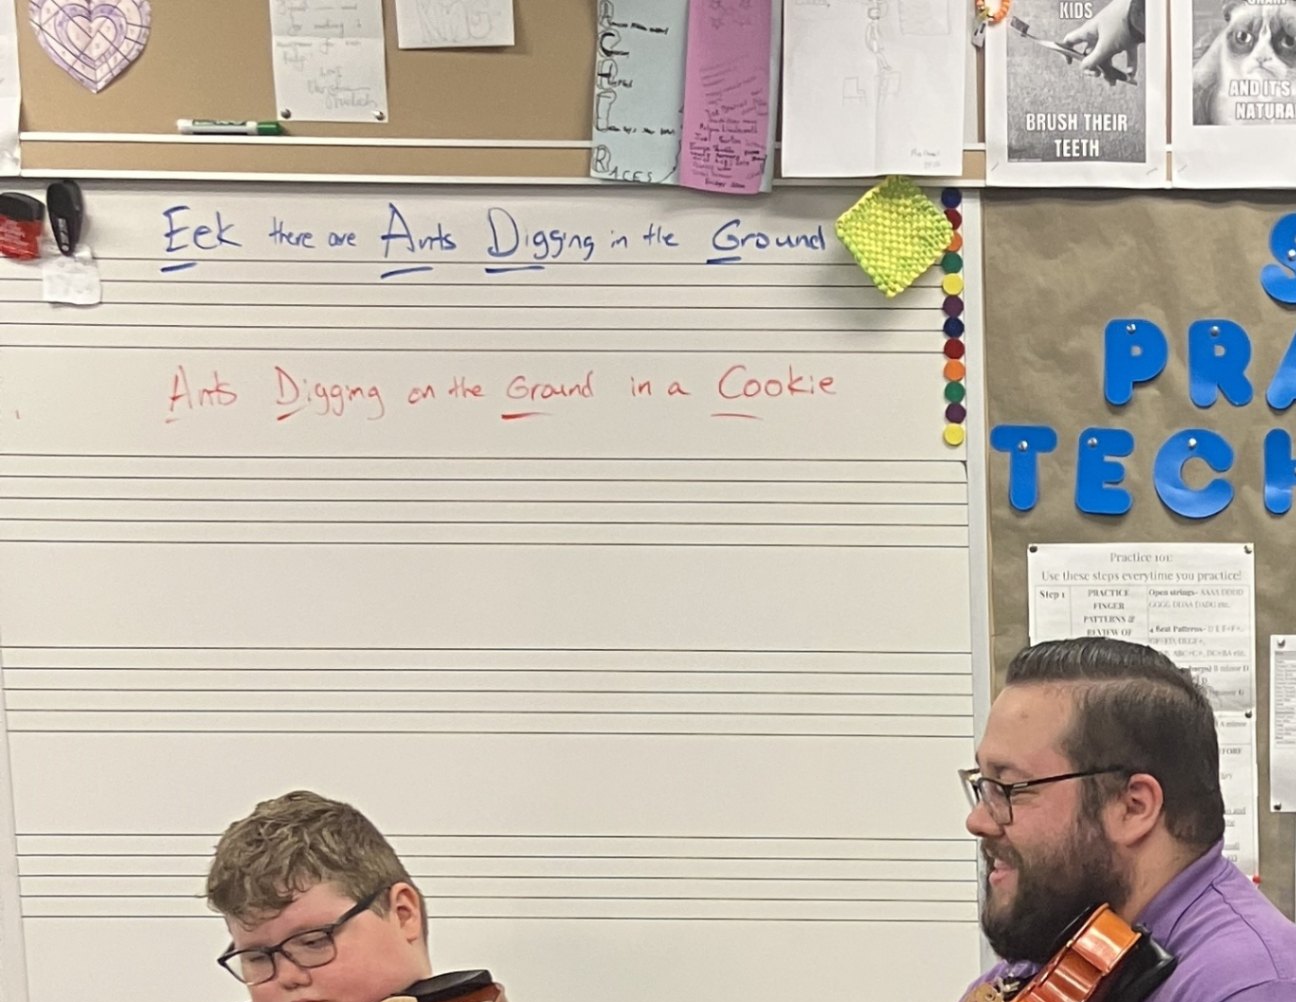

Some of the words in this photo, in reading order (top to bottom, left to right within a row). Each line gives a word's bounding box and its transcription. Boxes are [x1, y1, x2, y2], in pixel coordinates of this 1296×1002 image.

[1059, 1, 1093, 19] KIDS
[1229, 79, 1259, 97] AND
[1262, 80, 1291, 97] IT'S
[1026, 113, 1078, 131] BRUSH
[1084, 113, 1128, 131] THEIR
[1054, 139, 1100, 157] TEETH
[162, 205, 242, 252] Eek
[269, 217, 316, 248] there
[328, 231, 357, 247] are
[381, 202, 457, 258] Ants
[486, 207, 595, 260] Digging
[611, 231, 628, 248] in
[643, 224, 679, 247] the
[712, 219, 826, 251] Ground
[169, 365, 237, 412] Ants
[275, 366, 385, 421] Digging
[407, 383, 435, 404] on
[448, 376, 485, 398] the
[506, 370, 595, 400] Ground
[631, 377, 651, 396] in
[668, 381, 691, 396] a
[718, 364, 837, 400] Cookie
[1110, 552, 1152, 563] Practice
[1042, 570, 1059, 581] Use
[1062, 570, 1089, 581] these
[1092, 571, 1119, 583] steps
[1122, 571, 1174, 583] everytime
[1176, 573, 1195, 583] you
[1197, 570, 1242, 583] practice!
[1040, 590, 1059, 600] Step
[1087, 589, 1129, 597] PRACTICE
[1149, 589, 1169, 597] Open
[1093, 602, 1125, 610] FINGER
[1083, 615, 1126, 623] PATTERNS
[1087, 628, 1118, 636] REVIEW
